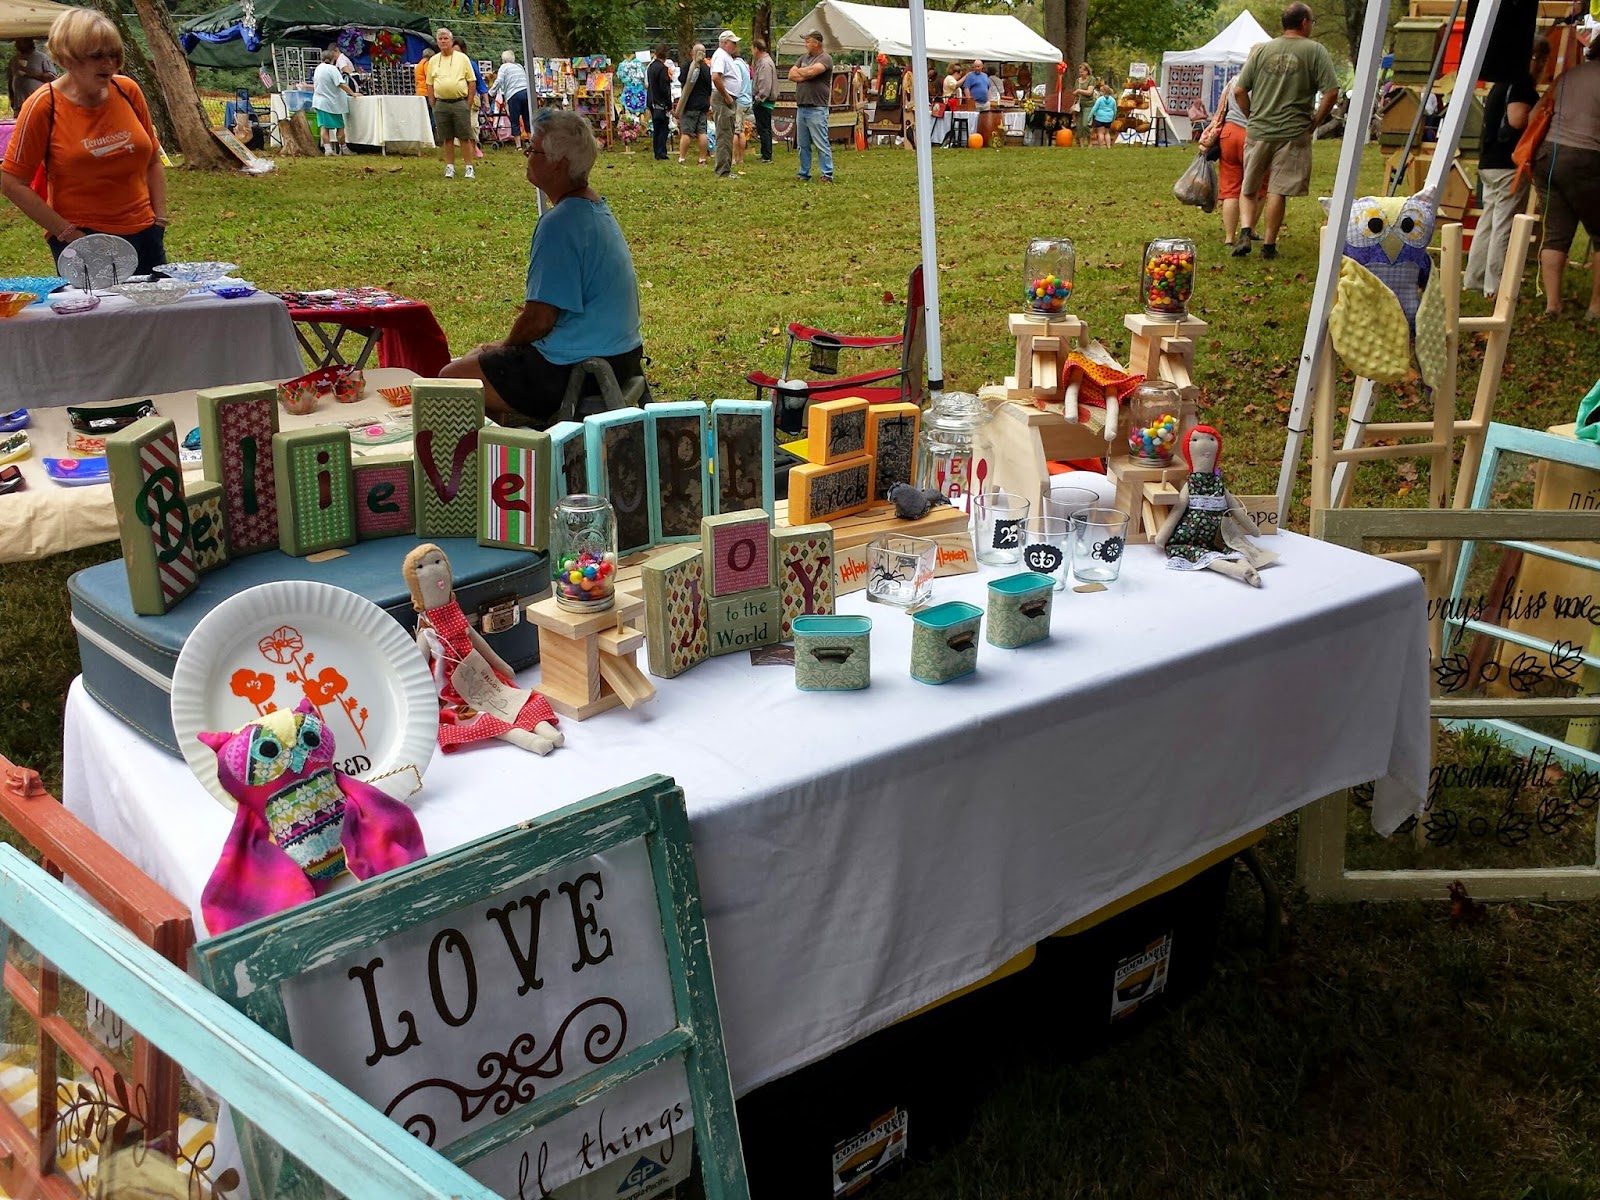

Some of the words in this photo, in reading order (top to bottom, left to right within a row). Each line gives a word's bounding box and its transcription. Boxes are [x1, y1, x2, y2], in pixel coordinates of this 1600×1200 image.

[80, 131, 129, 150] Tennessee
[726, 605, 739, 622] to
[744, 600, 769, 614] the
[1499, 576, 1548, 620] kiss
[716, 622, 769, 648] World
[1425, 745, 1555, 811] goodnight
[348, 871, 614, 1067] LOVE
[518, 1141, 553, 1200] ll
[577, 1101, 685, 1175] things
[627, 1163, 656, 1185] GP
